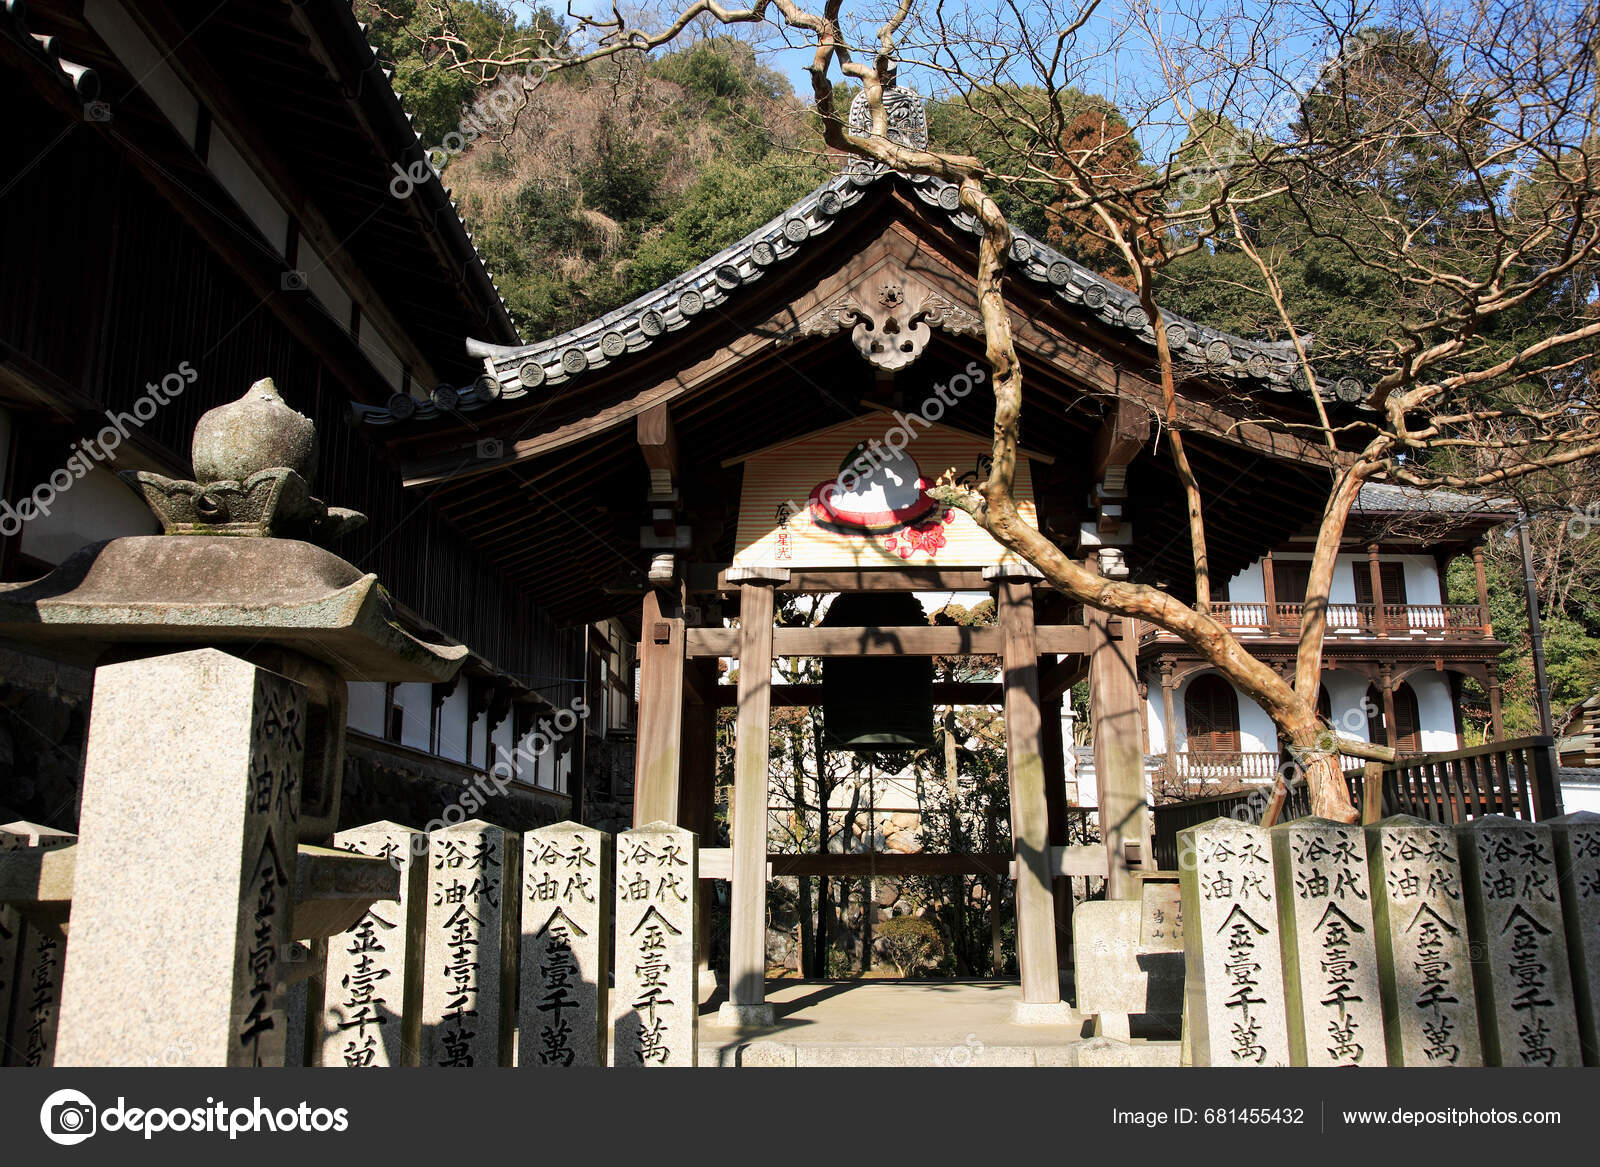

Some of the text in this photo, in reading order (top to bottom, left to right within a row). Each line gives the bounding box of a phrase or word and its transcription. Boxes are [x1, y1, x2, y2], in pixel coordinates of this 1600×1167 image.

[434, 839, 470, 907] 浴油
[467, 832, 500, 908] 永代
[526, 837, 565, 901] 浴油
[563, 834, 597, 903] 永代
[618, 837, 652, 901] 浴油
[655, 835, 689, 904] 永代
[1199, 837, 1236, 901] 浴油
[1238, 832, 1272, 902] 永代
[1292, 834, 1331, 899] 浴油
[1331, 830, 1368, 901] 永代
[1384, 833, 1424, 900] 浴油
[1424, 830, 1460, 901] 永代
[1479, 833, 1519, 901] 浴油
[1519, 831, 1556, 903] 永代
